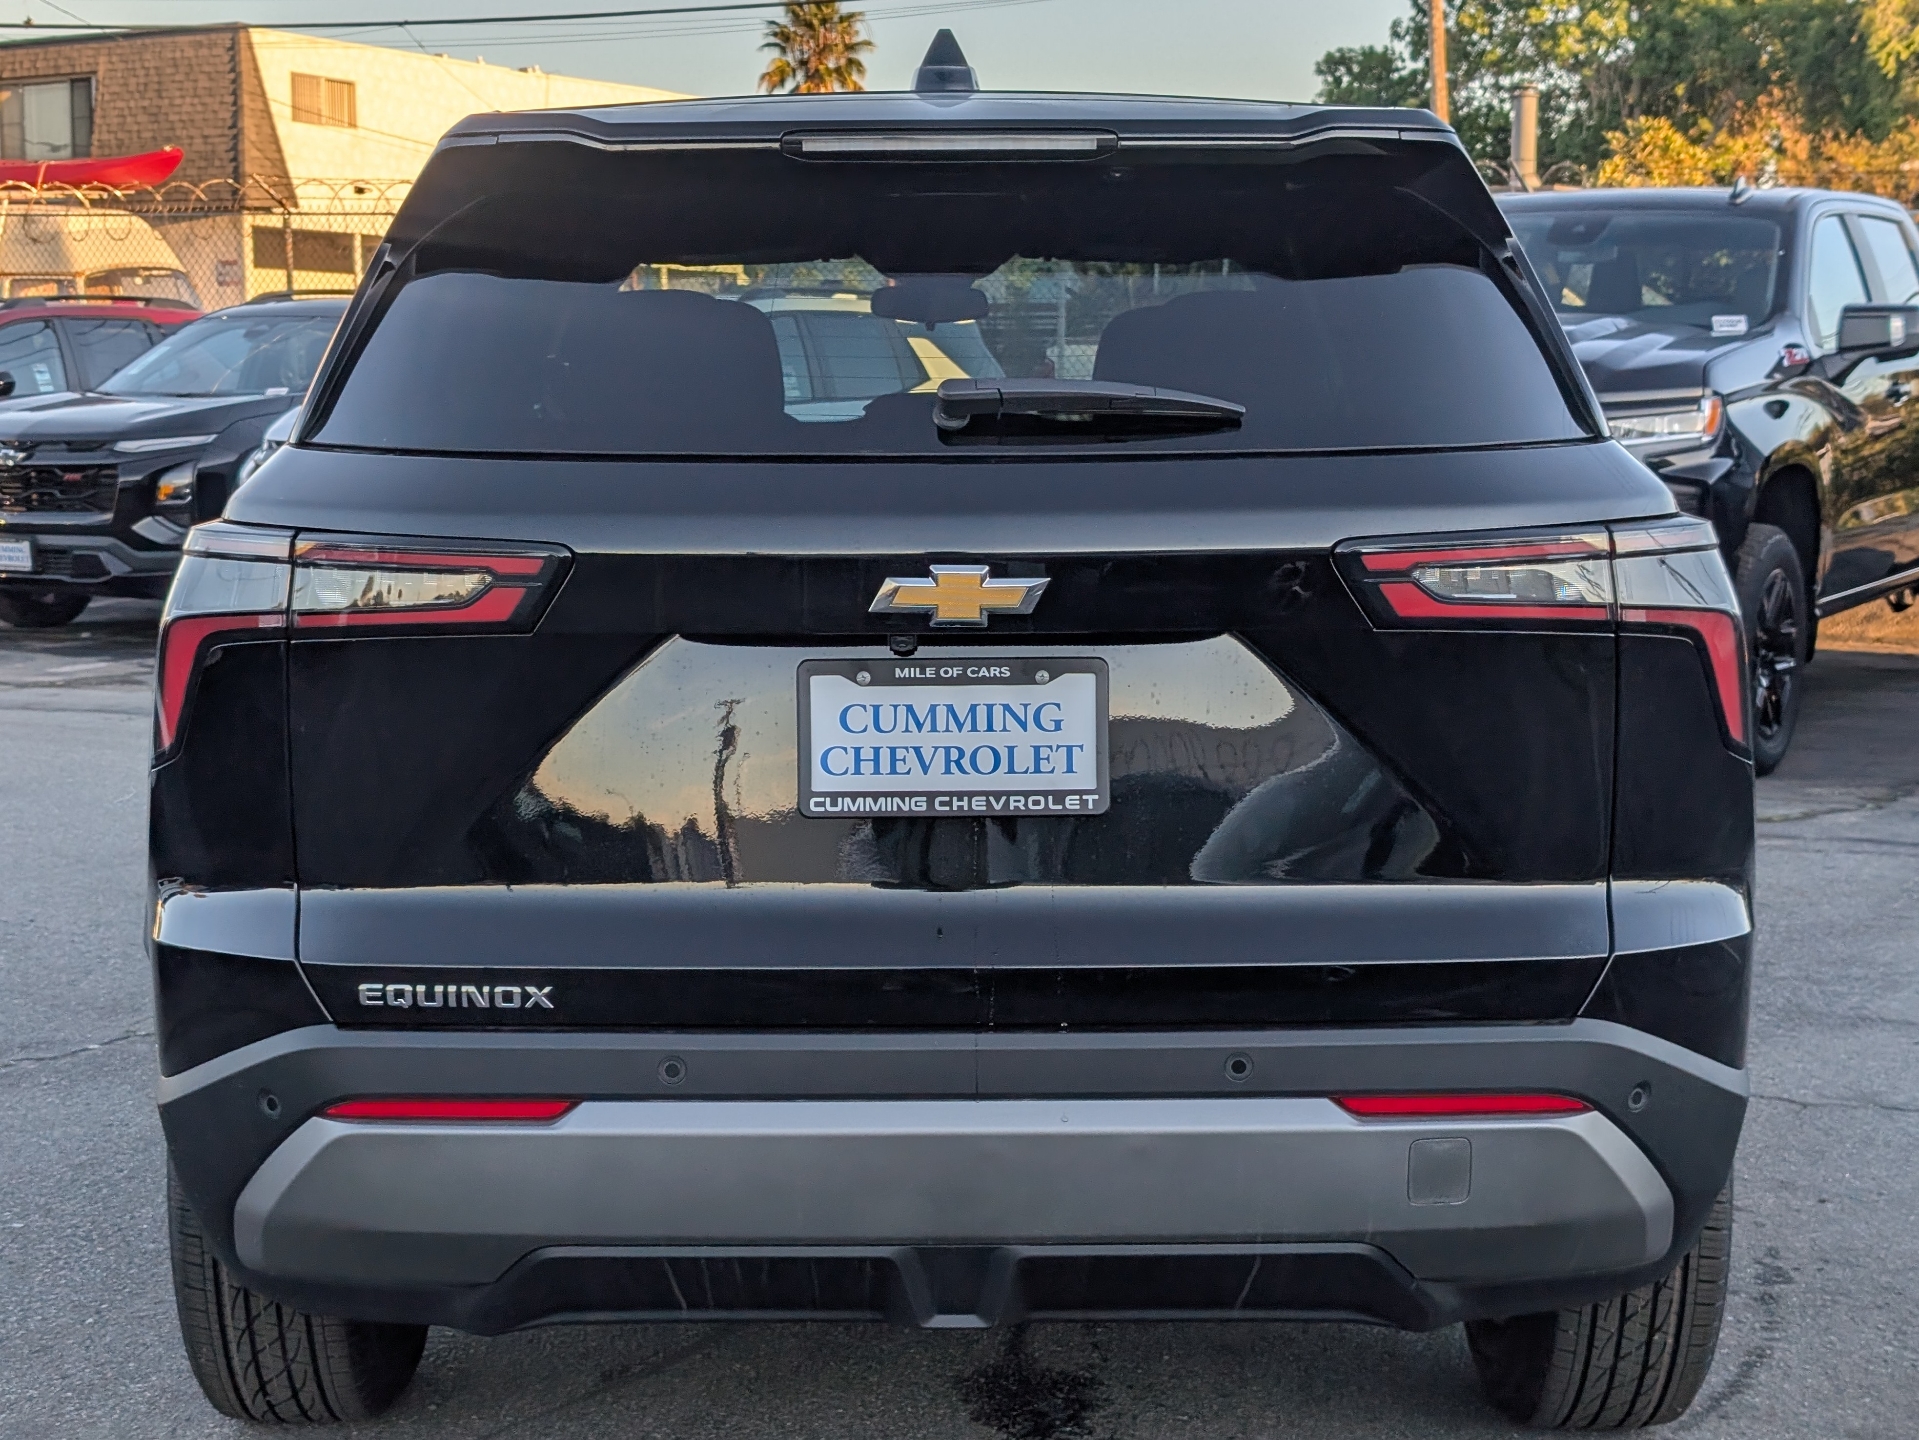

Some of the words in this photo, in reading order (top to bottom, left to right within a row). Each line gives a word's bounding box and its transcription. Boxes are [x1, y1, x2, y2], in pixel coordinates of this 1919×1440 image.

[895, 667, 936, 679] MILE
[939, 667, 963, 678] OF
[967, 666, 1011, 678] CARS
[838, 702, 1065, 734] CUMMING
[819, 743, 1084, 776] CHEVROLET
[809, 796, 927, 812] CUMMING
[934, 794, 1099, 811] CHEVROLET
[358, 983, 554, 1009] EQUINOX
